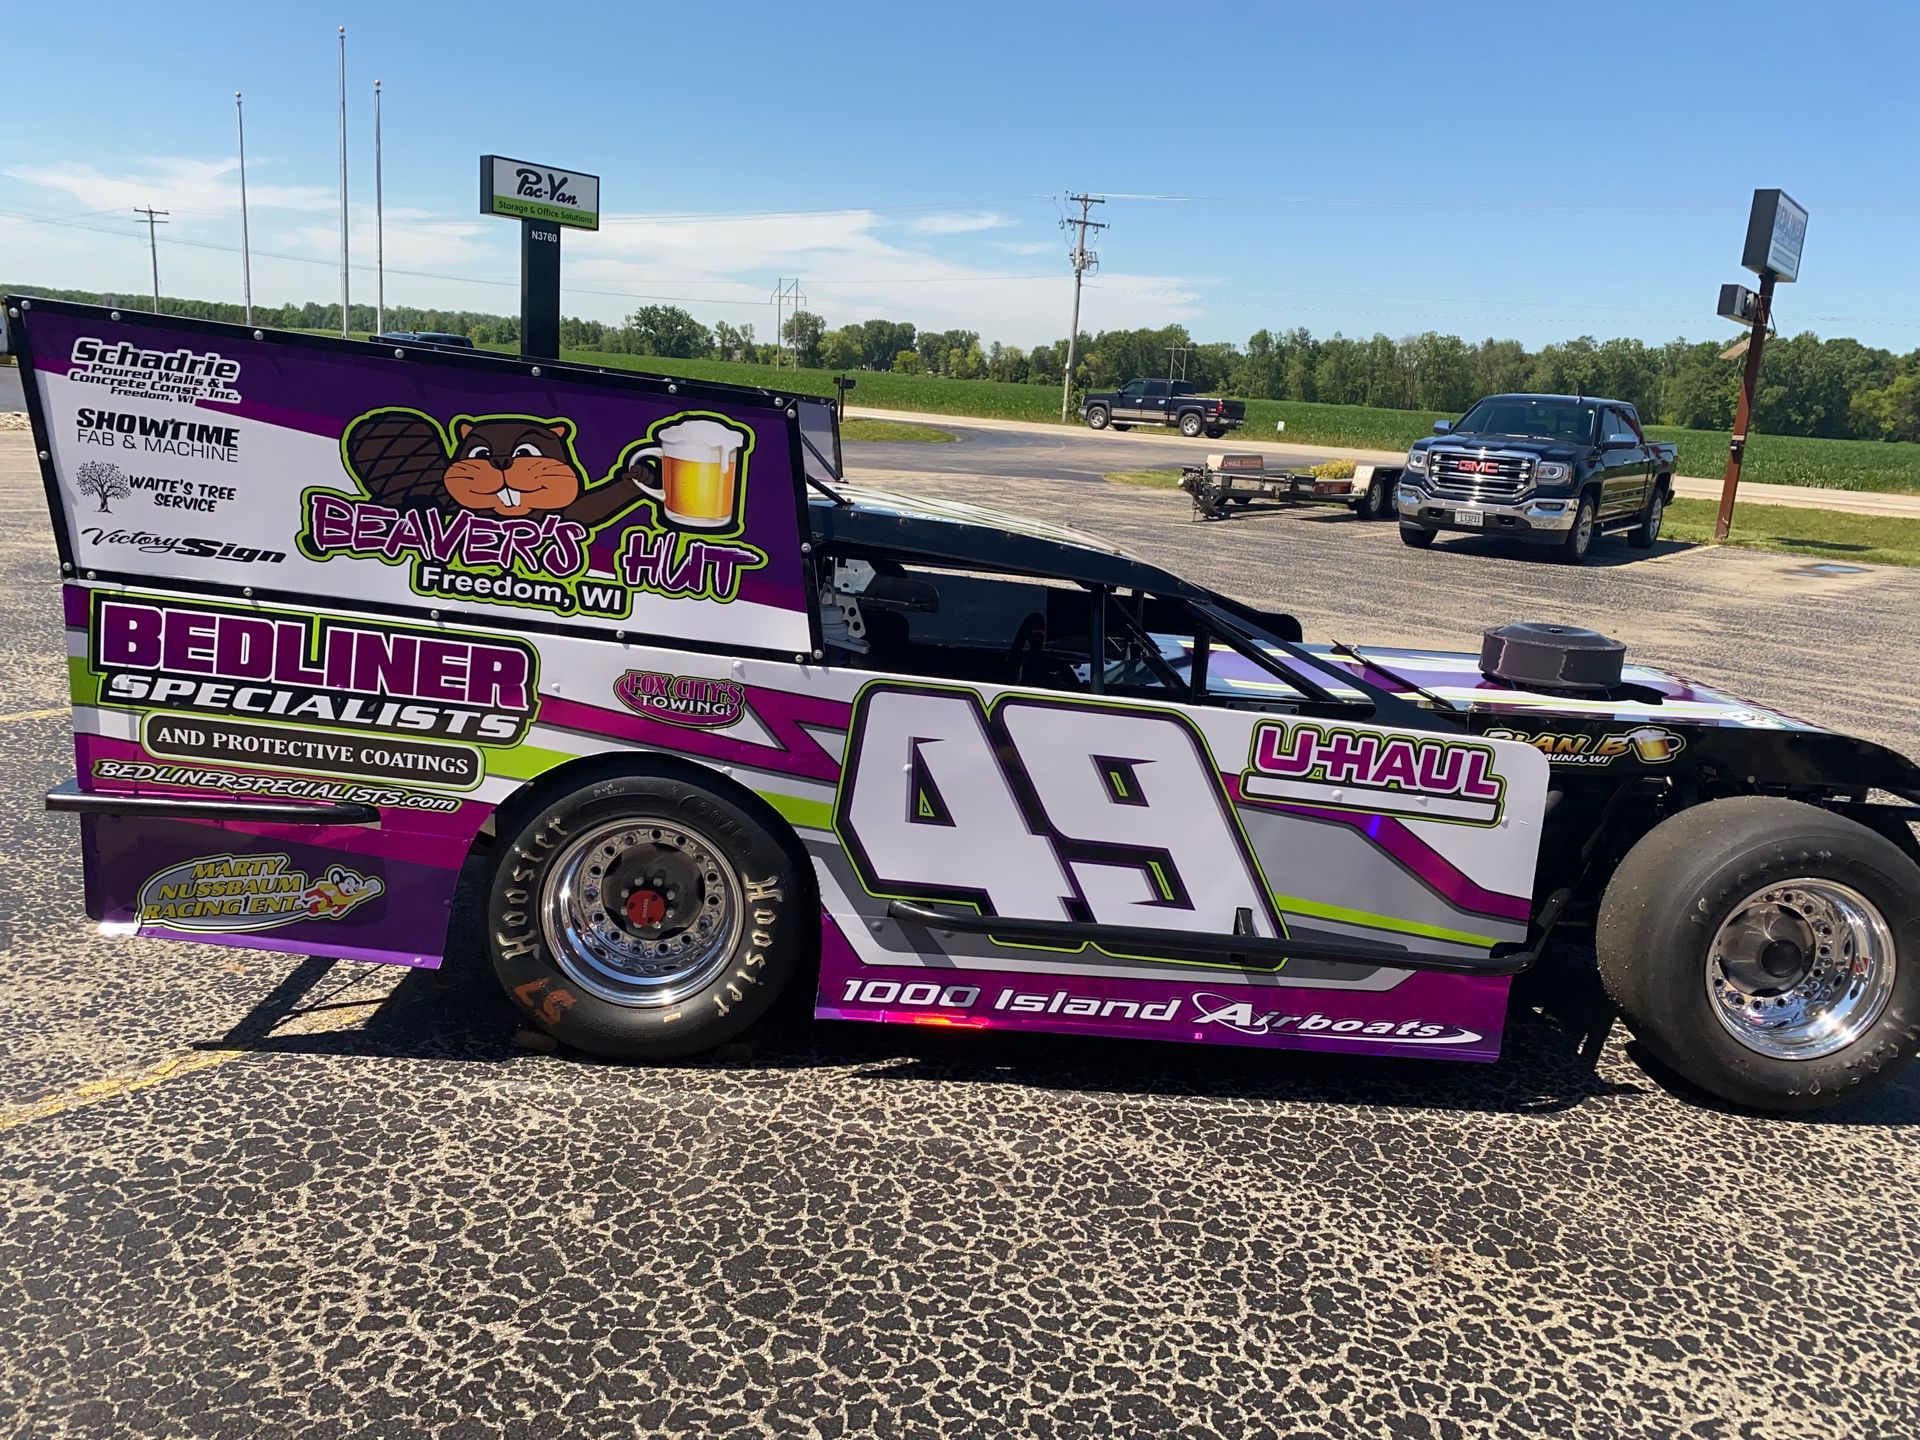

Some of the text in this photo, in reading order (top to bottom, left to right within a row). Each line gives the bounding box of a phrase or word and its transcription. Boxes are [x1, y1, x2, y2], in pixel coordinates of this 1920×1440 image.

[516, 168, 578, 205] Pac-Van
[498, 201, 593, 224] Storage & Office Solutions
[531, 230, 558, 243] N3760
[73, 339, 239, 380] Schadrie
[70, 371, 146, 389] Concrete
[209, 388, 239, 401] Inc.
[91, 364, 220, 388] Poured Walls &
[178, 394, 194, 404] WI
[76, 408, 240, 448] SHOWTIME
[78, 429, 239, 463] FAB & MACHINE
[1457, 460, 1500, 474] GMC
[129, 475, 237, 500] WAITE'S TREE
[154, 493, 217, 512] SERVICE
[311, 495, 760, 596] BEAVER'S HUT
[421, 565, 621, 610] Freedom, WI
[100, 601, 529, 710] BEDLINER
[627, 672, 668, 697] FOX
[108, 672, 522, 738] SPECIALISTS
[640, 695, 724, 715] TOWING
[156, 726, 468, 774] AND PROTECTIVE COATINGS
[1546, 753, 1588, 764] AUNA,
[1592, 736, 1630, 755] B
[1258, 725, 1500, 799] U-HAUL
[98, 762, 456, 811] BEDLINERSPECIALISTS.com
[842, 688, 1285, 945] 49
[190, 858, 284, 880] MARTY
[158, 876, 302, 900] NUSSBAUM
[142, 895, 304, 920] RACING ENT.
[842, 979, 1446, 1037] 1000 Island Airboats
